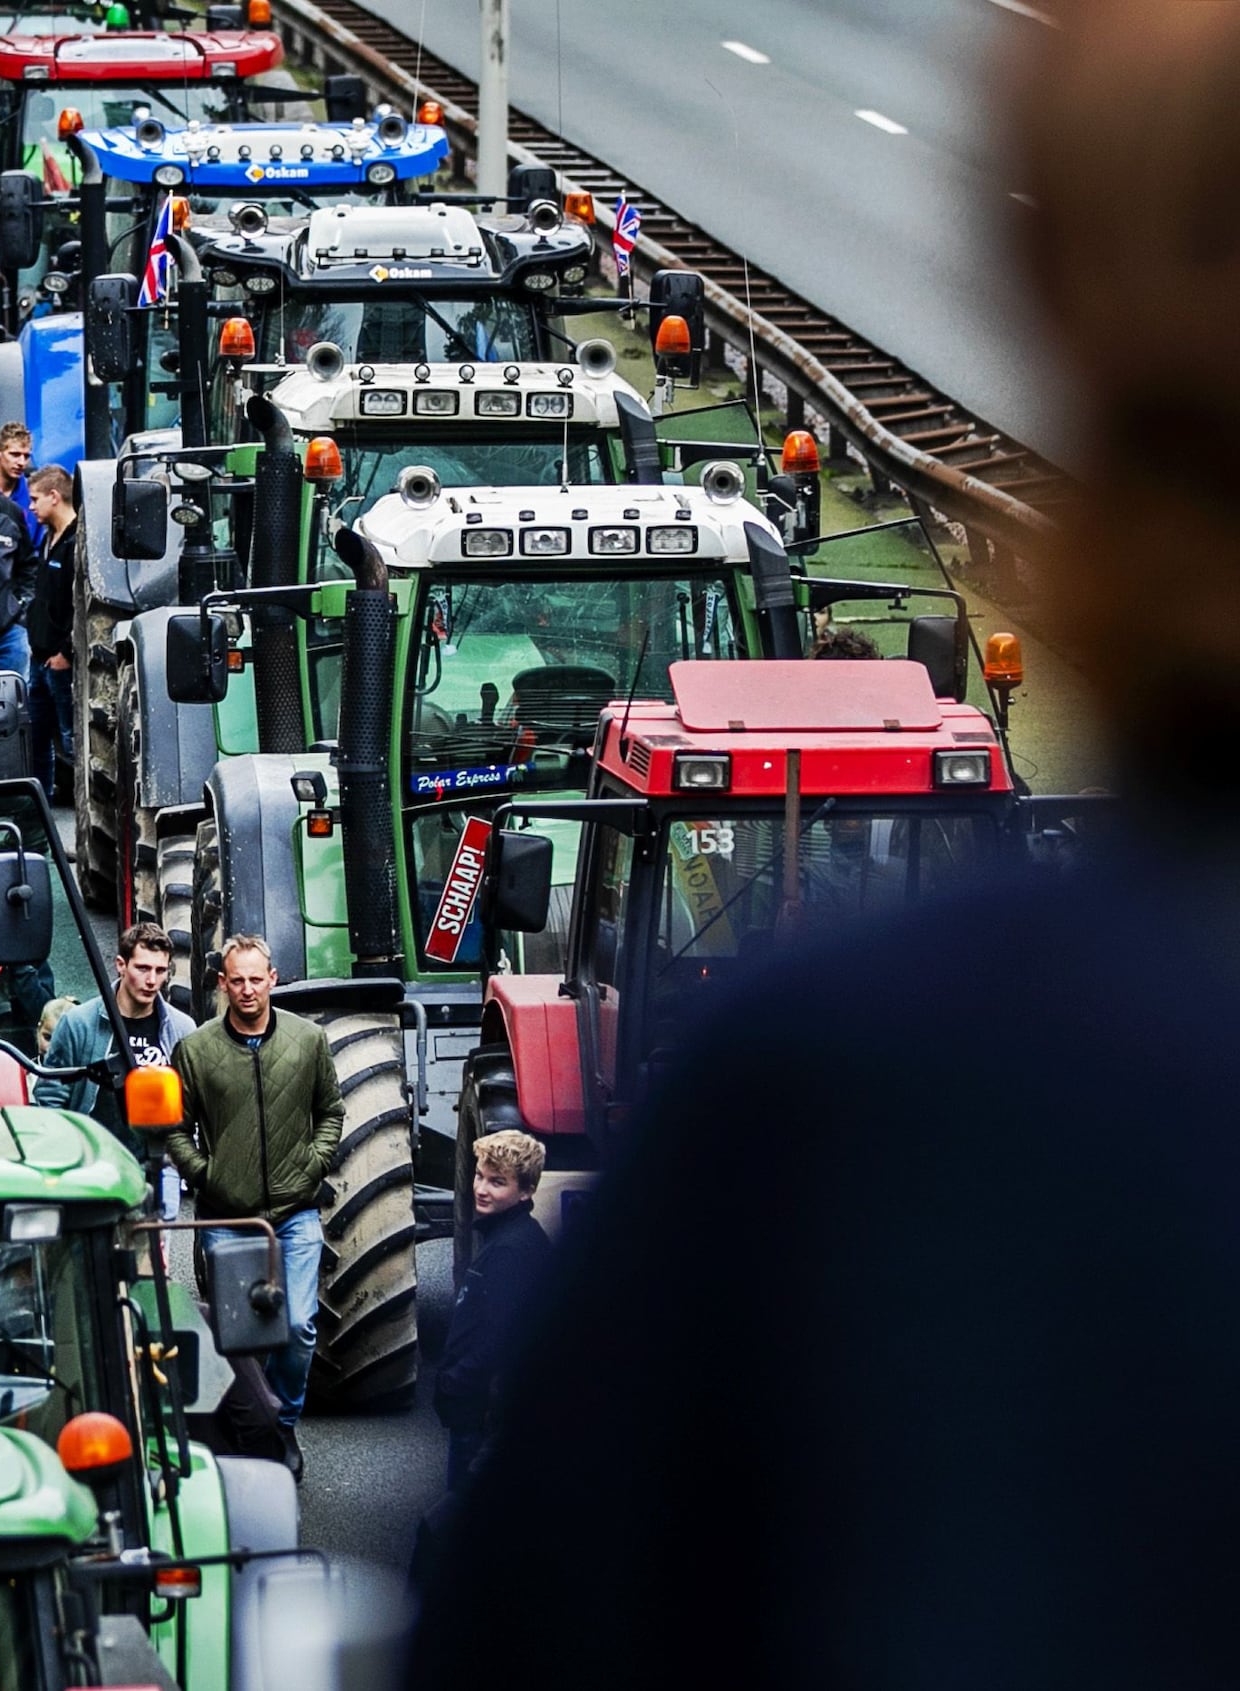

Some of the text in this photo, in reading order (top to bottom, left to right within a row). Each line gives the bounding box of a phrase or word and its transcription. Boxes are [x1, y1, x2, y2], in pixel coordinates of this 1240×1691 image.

[265, 166, 309, 179] Oskam
[389, 267, 432, 279] Oskam
[417, 770, 501, 792] Polar Express
[686, 829, 735, 854] 153
[437, 845, 486, 935] SCHAAP!
